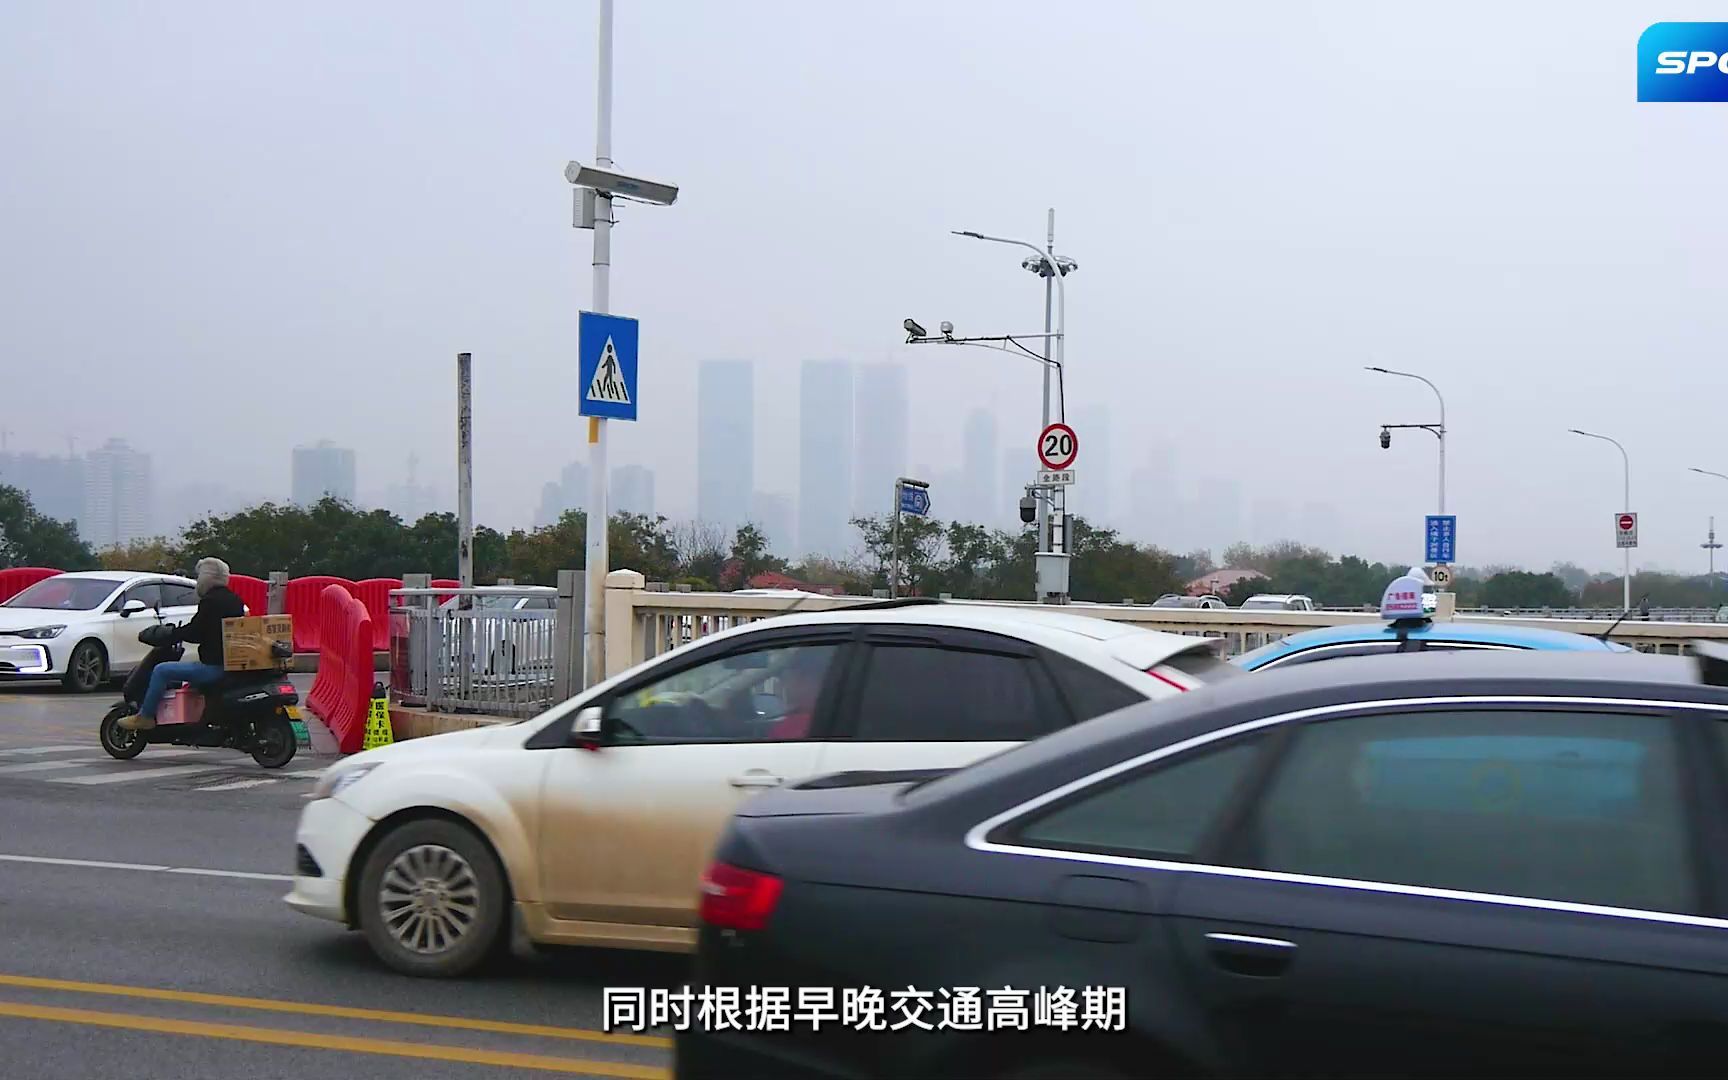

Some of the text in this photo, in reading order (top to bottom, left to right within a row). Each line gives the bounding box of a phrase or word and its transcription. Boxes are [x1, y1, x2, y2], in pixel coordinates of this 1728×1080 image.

[1045, 434, 1072, 457] 20
[1043, 473, 1070, 482] 全路段
[1434, 571, 1448, 582] 10t
